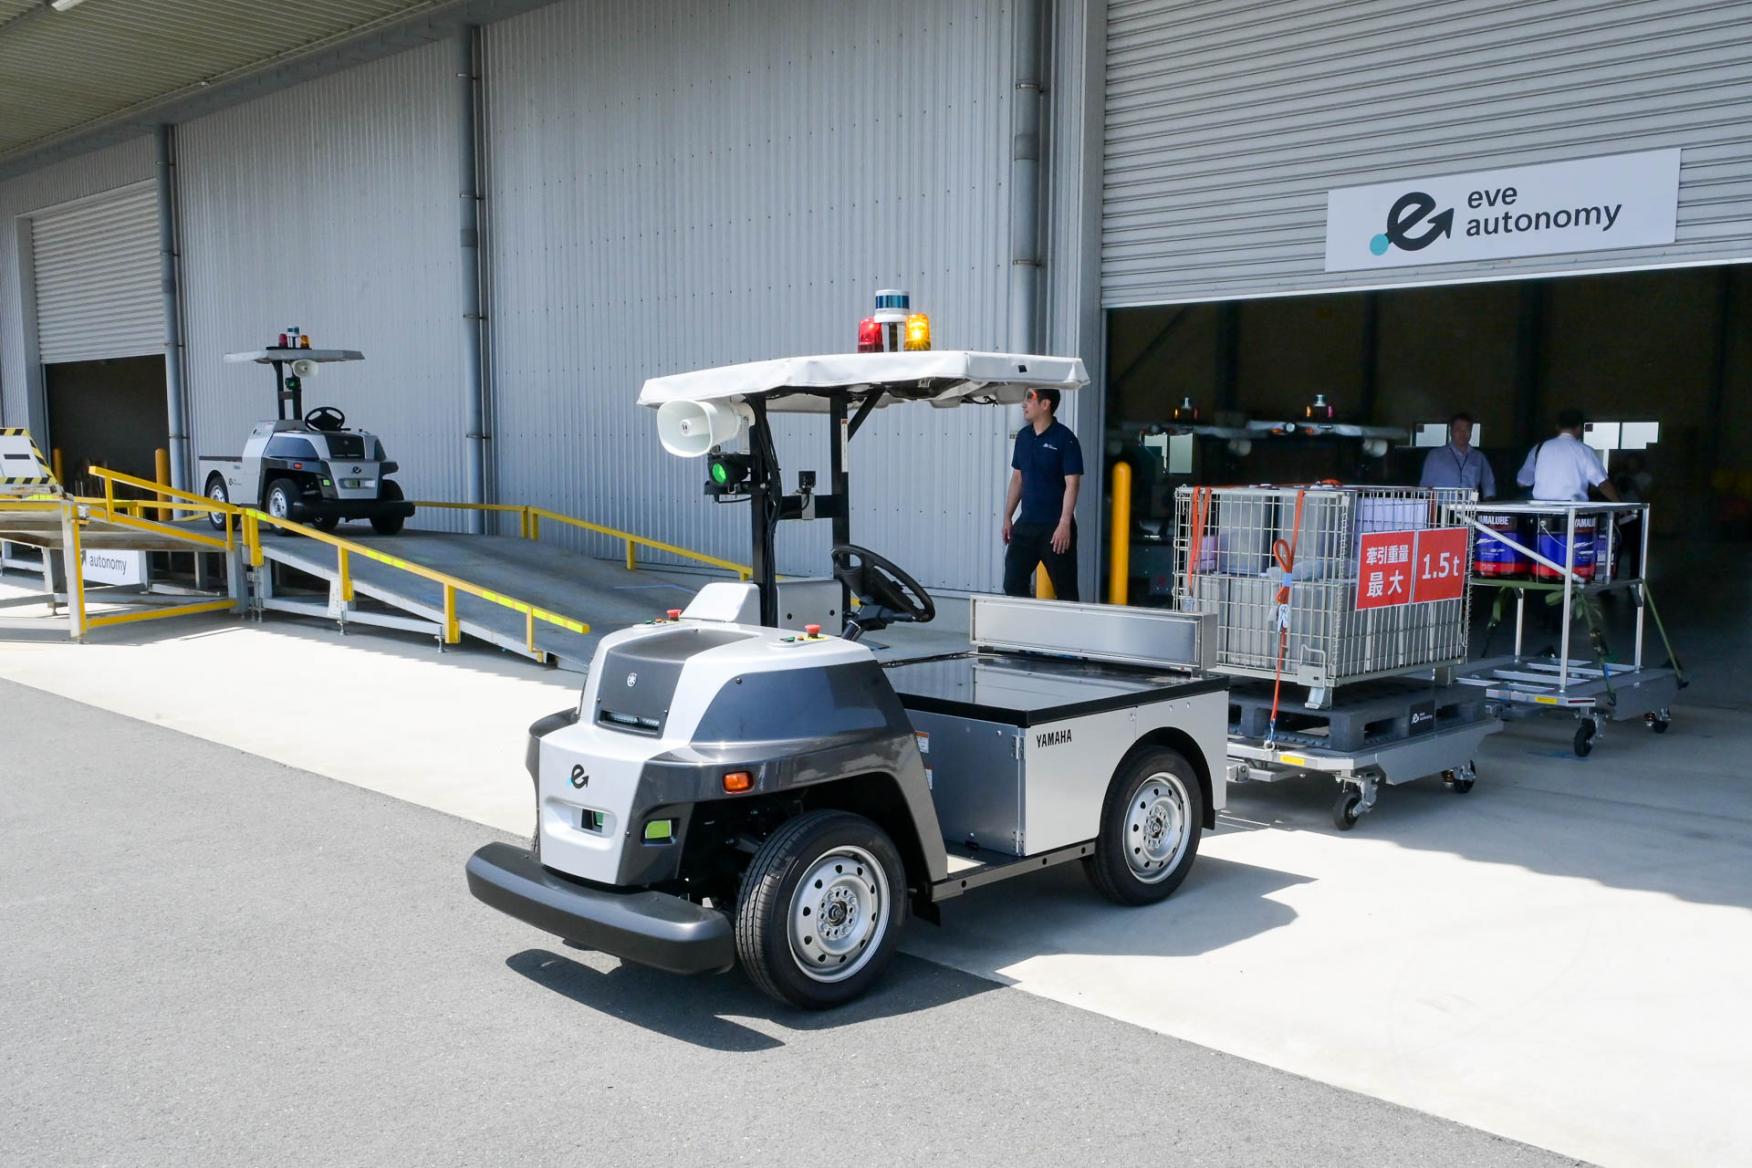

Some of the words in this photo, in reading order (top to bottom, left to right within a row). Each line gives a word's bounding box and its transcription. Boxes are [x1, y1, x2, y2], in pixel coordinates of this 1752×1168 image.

[1467, 187, 1517, 208] eve
[1466, 204, 1622, 237] autonomy
[90, 555, 127, 575] autonomy
[1366, 544, 1409, 565] 牽引重量
[1036, 728, 1072, 748] YAMAHA
